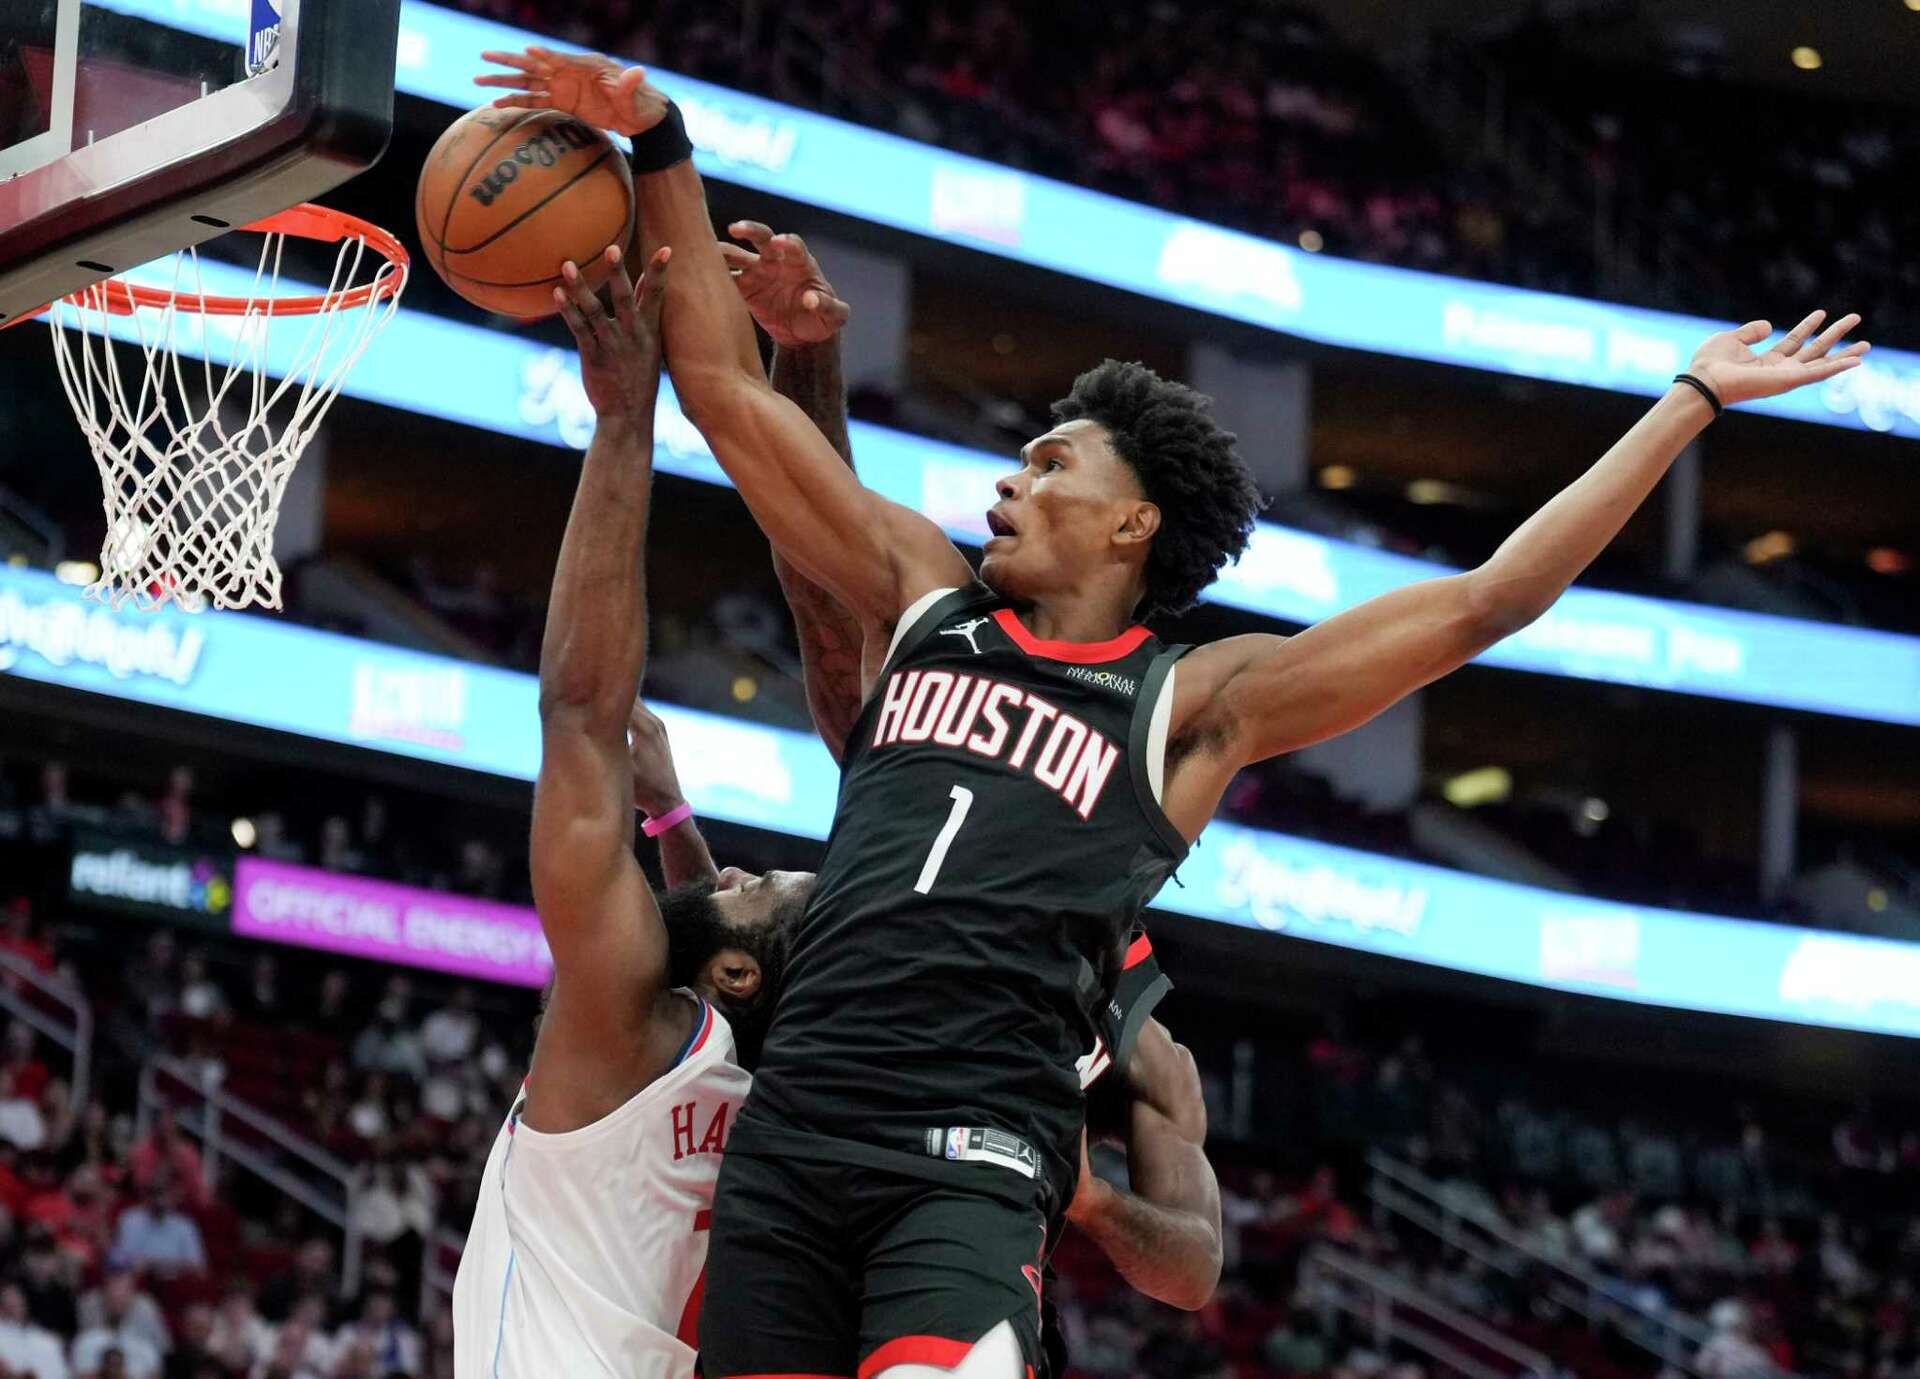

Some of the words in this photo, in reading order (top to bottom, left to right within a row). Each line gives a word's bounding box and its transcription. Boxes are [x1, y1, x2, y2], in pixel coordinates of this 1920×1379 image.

[872, 669, 1120, 822] HOUSTON
[913, 784, 974, 895] 1
[246, 878, 400, 944] OFFICIAL
